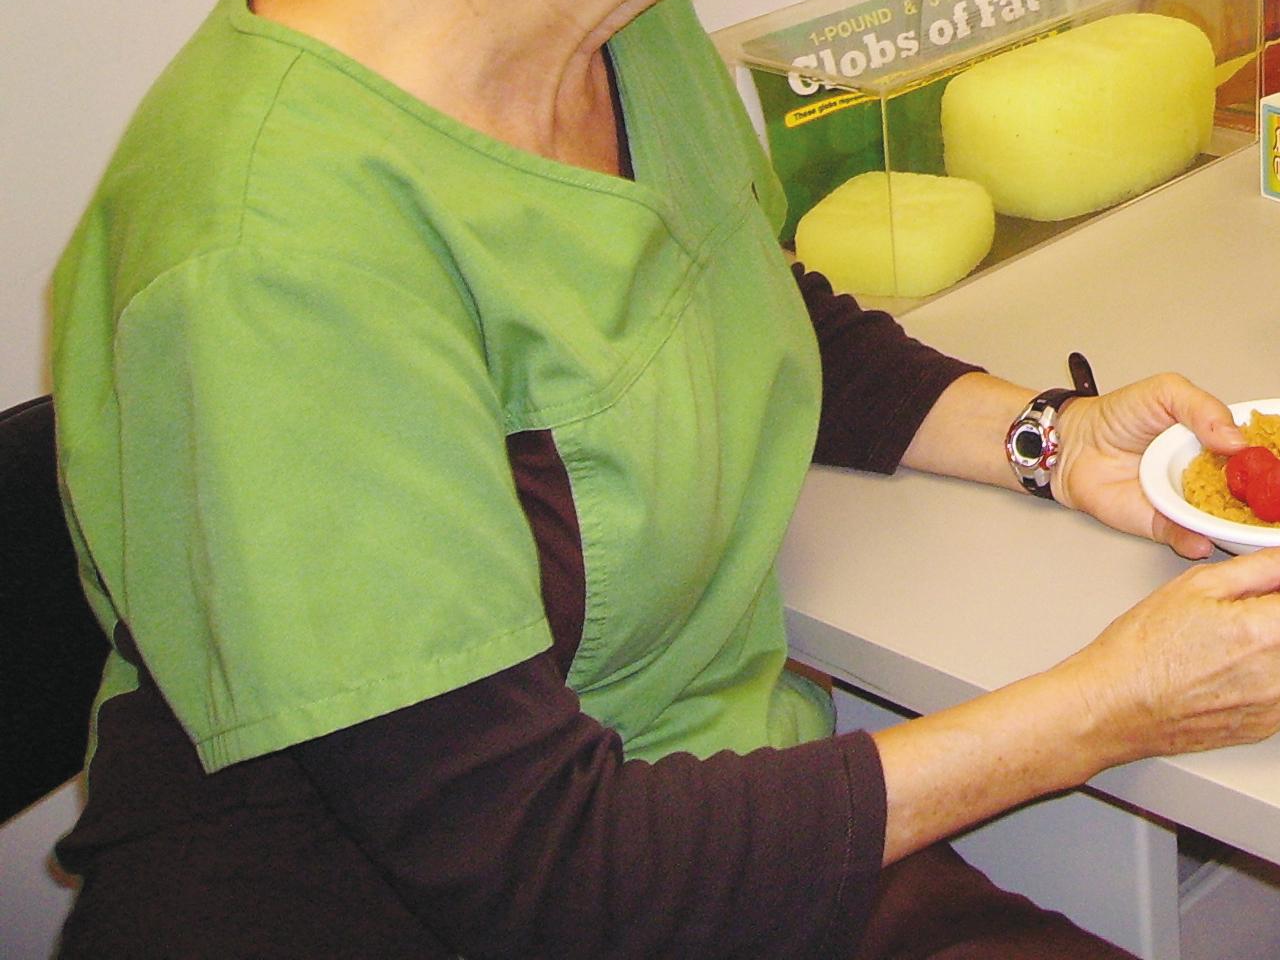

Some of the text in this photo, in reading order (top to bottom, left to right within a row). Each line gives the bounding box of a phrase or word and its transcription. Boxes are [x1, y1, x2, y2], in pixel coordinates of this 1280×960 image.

[787, 29, 920, 96] Globs
[928, 0, 971, 46] of
[809, 6, 894, 46] 1-POUND
[903, 0, 919, 16] &
